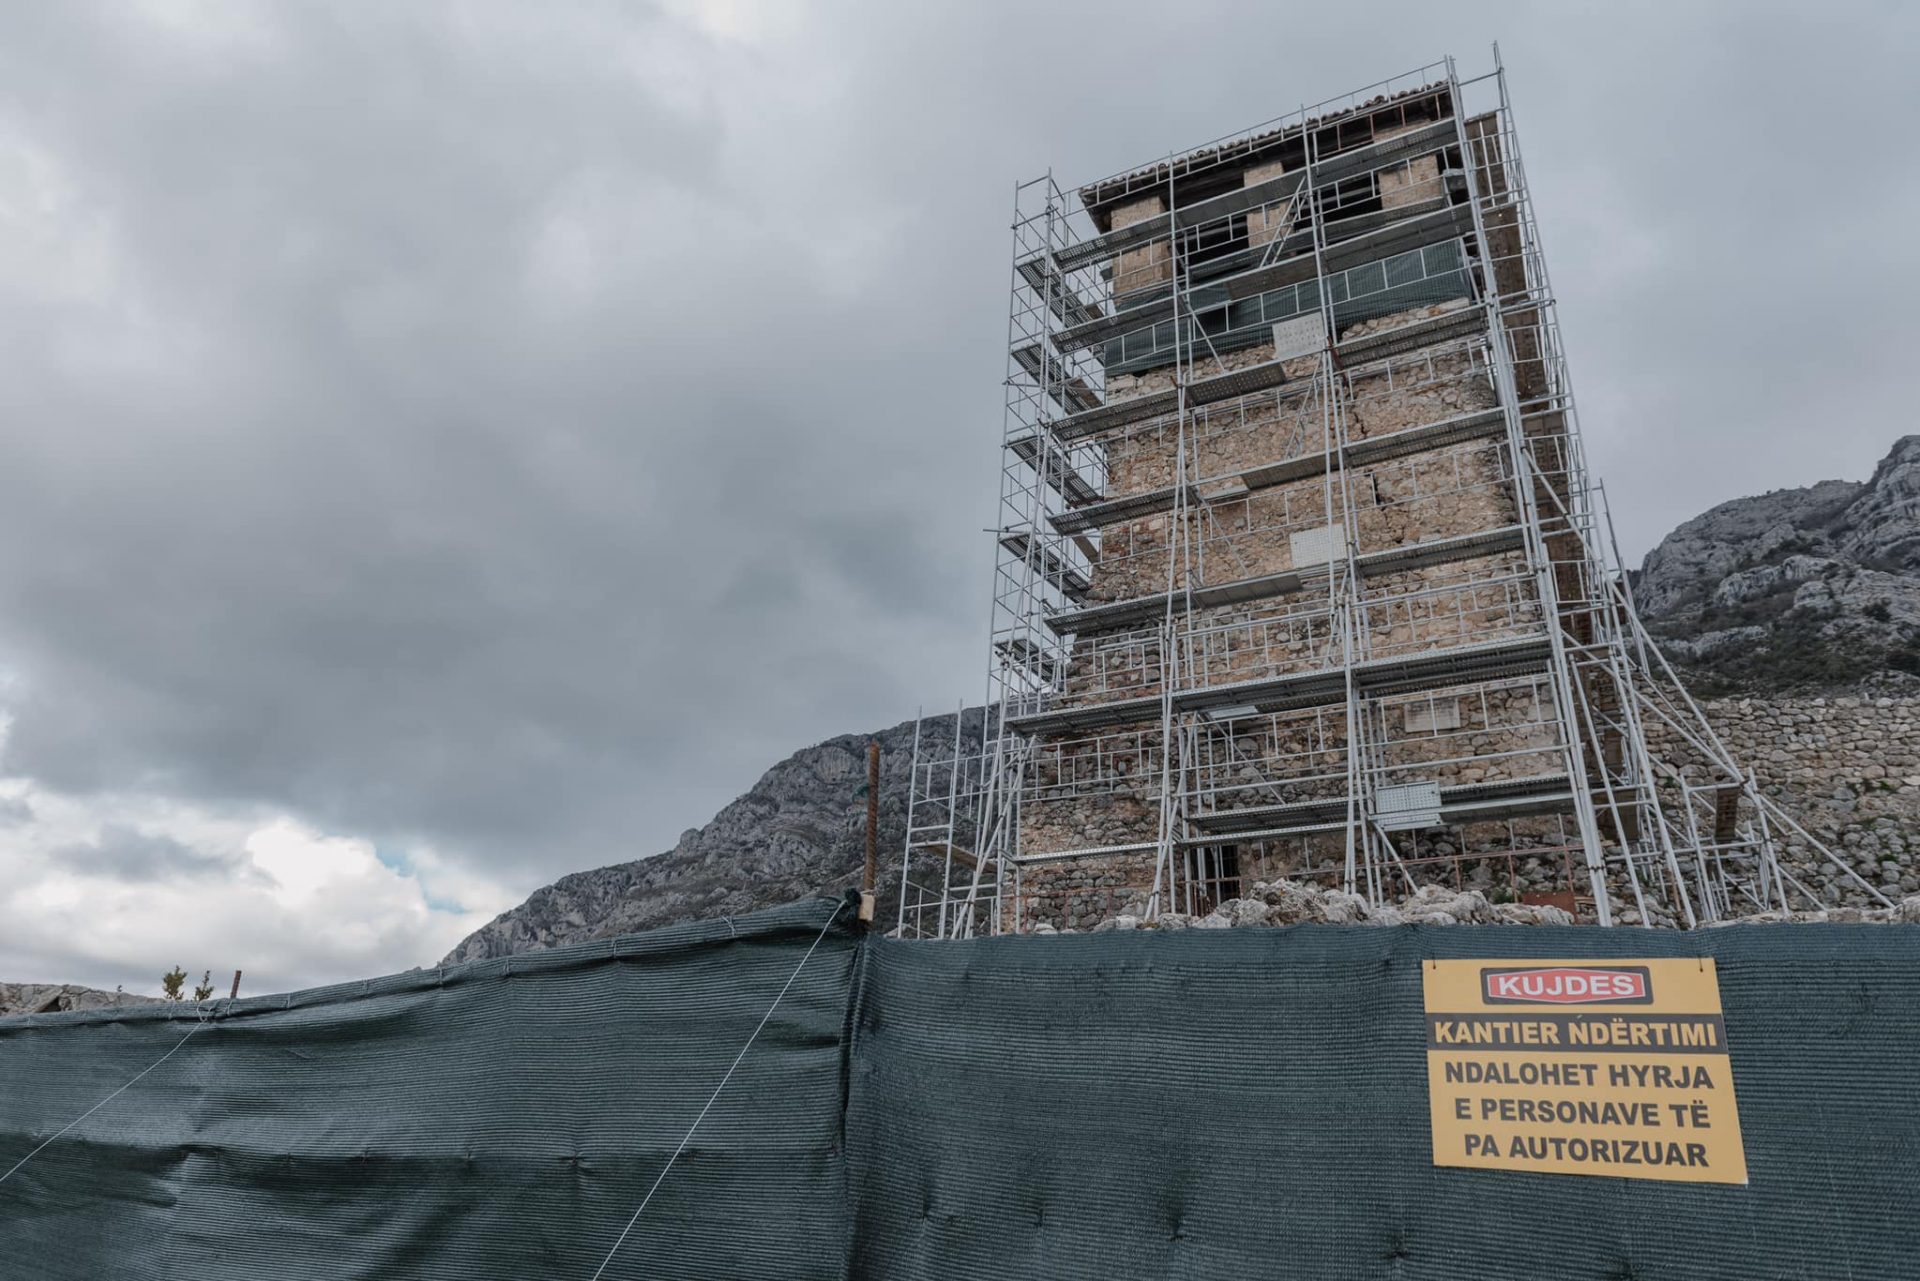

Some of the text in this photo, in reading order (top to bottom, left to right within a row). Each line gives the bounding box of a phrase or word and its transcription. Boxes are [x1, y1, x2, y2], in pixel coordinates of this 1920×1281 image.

[1499, 975, 1634, 996] KUJDES
[1435, 1018, 1718, 1047] KANTIER NDËRTIMI
[1445, 1062, 1715, 1089] NDALOHET HYRJA
[1455, 1098, 1711, 1128] E PERSONAVE TË
[1464, 1134, 1710, 1168] PA AUTORIZUAR
